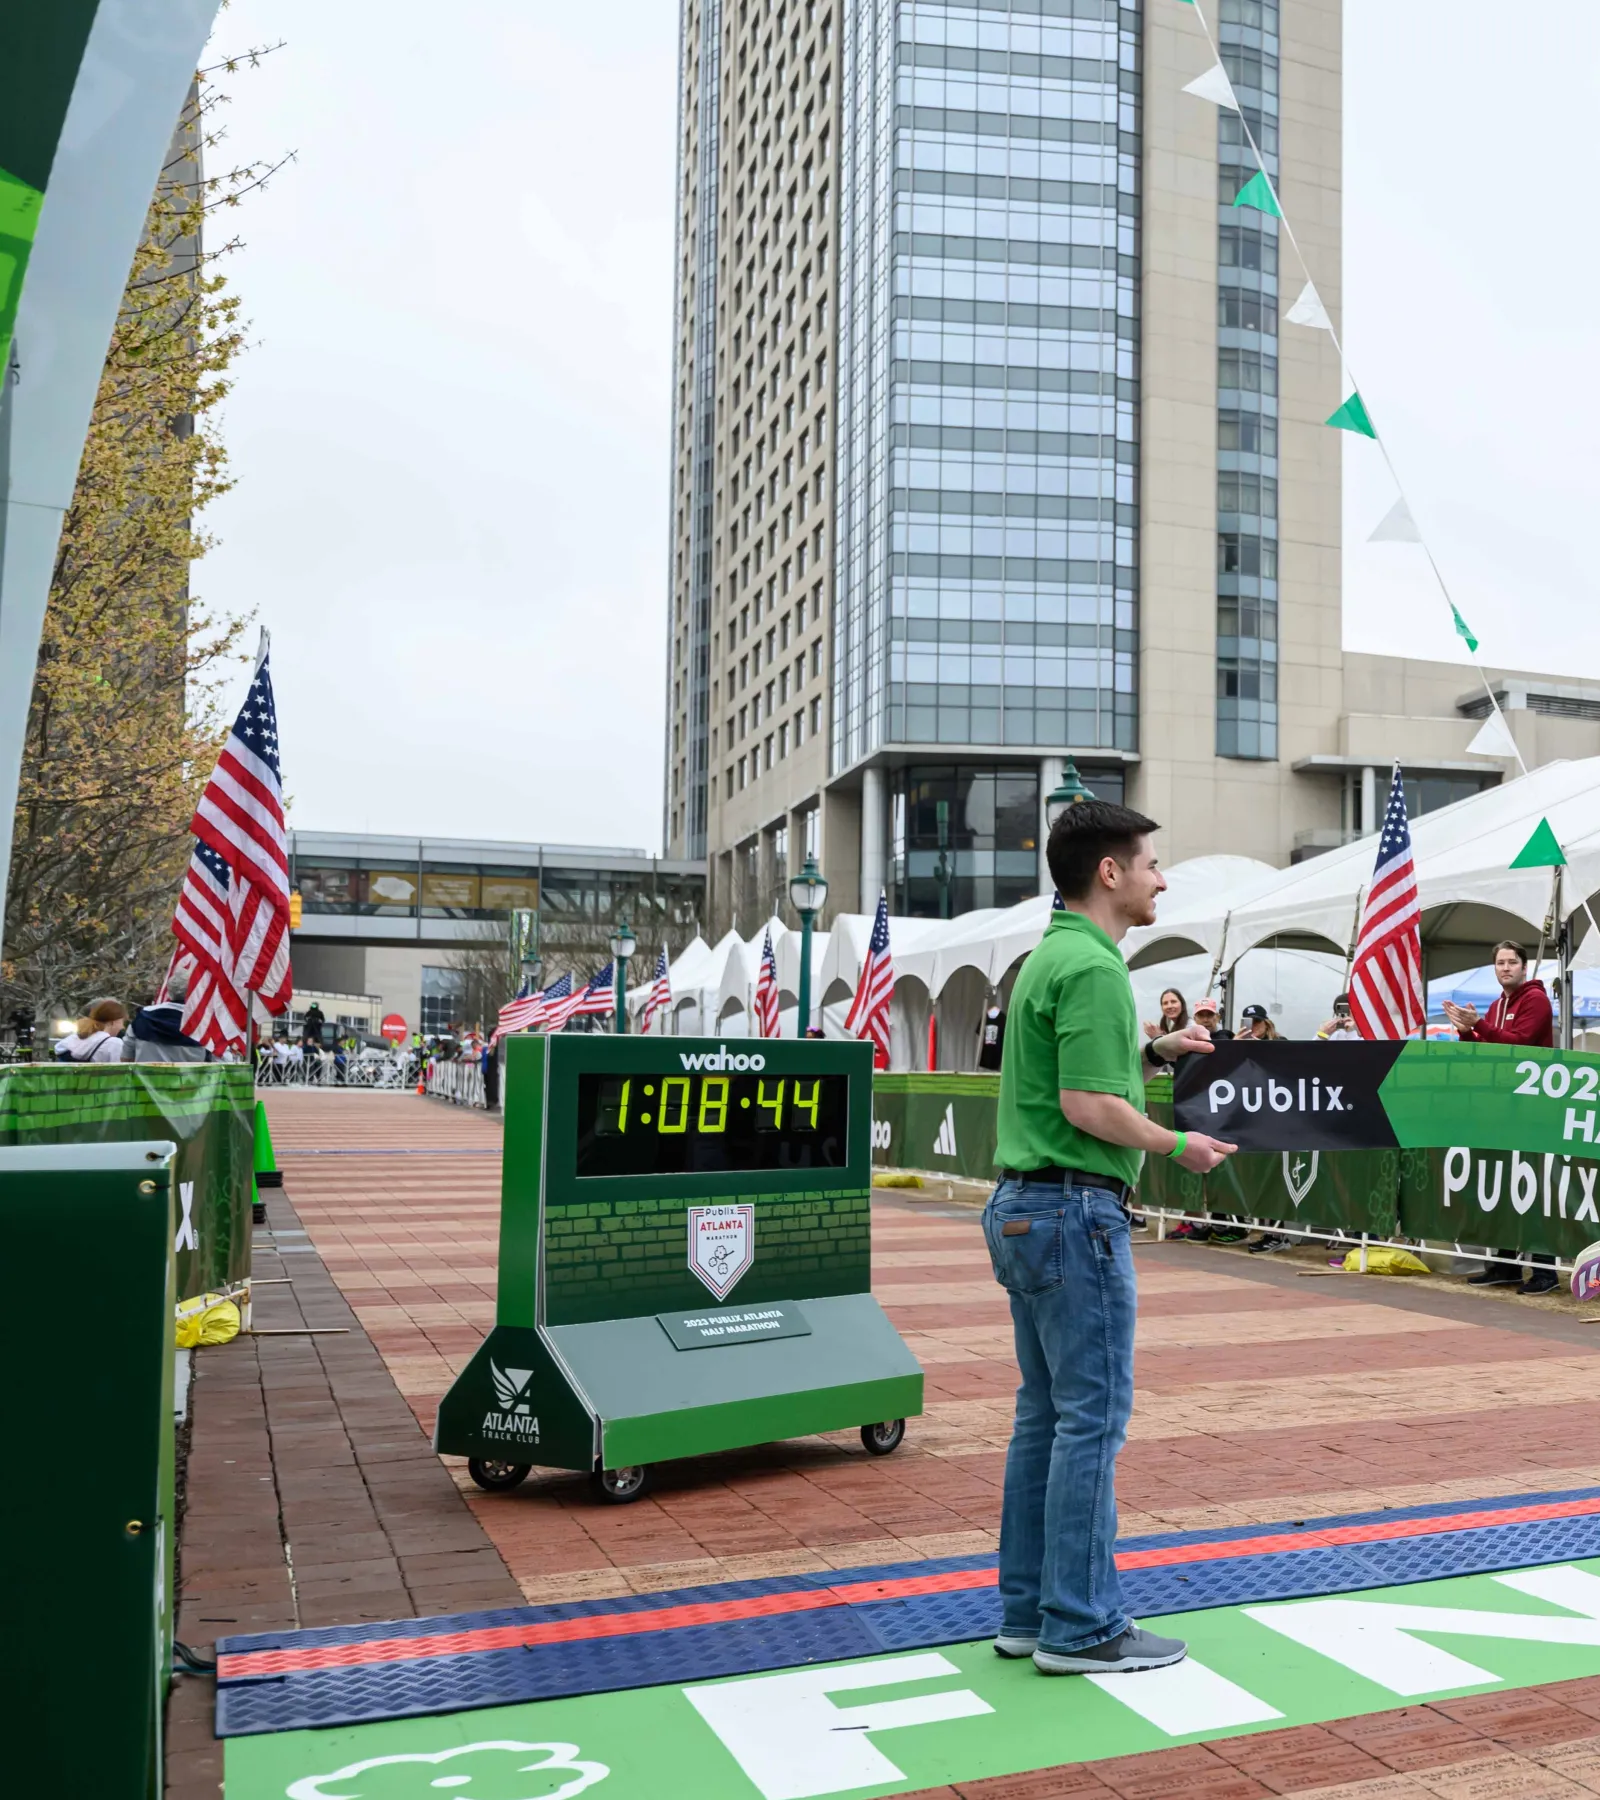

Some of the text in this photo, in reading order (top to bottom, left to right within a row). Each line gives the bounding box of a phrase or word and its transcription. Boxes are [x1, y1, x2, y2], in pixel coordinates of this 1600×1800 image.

[679, 1044, 766, 1072] wahoo
[1208, 1077, 1346, 1114] Publix
[705, 1206, 735, 1217] Publix
[700, 1219, 744, 1232] ATLANTA
[683, 1310, 785, 1328] 2023 PUBLIX ATLANTA
[700, 1320, 781, 1337] HALF MARATHON
[482, 1411, 540, 1435] ATLANTA
[482, 1429, 540, 1444] TRACK CLUB
